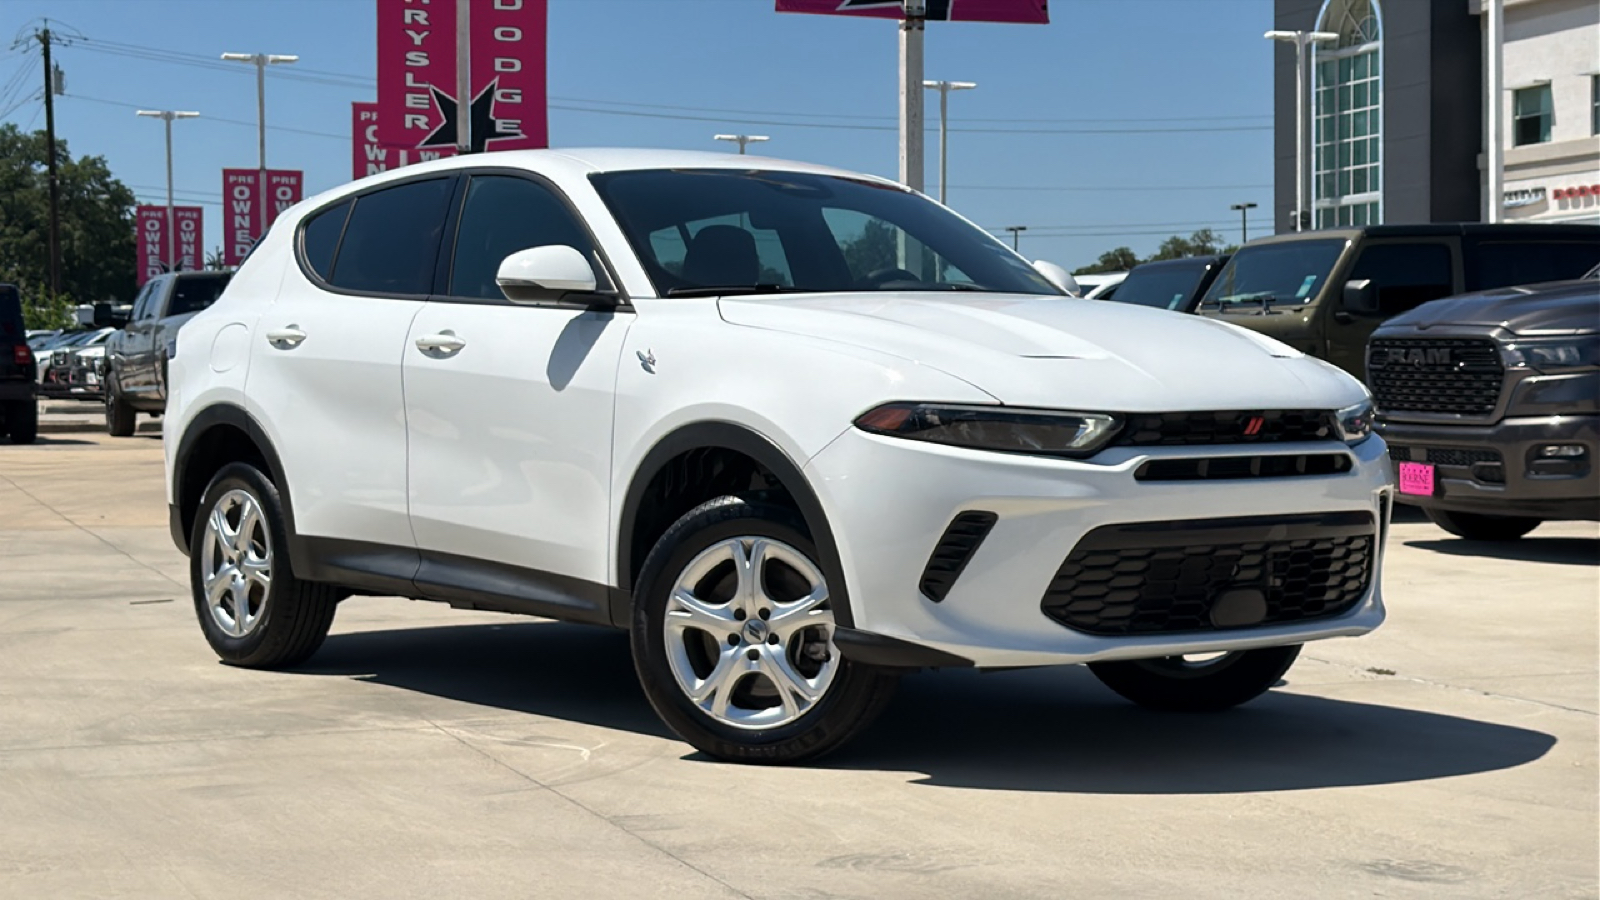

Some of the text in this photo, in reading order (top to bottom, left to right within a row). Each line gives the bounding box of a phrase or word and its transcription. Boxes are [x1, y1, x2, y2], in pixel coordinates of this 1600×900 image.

[404, 0, 430, 130] RYSLER
[493, 0, 522, 135] DODGE
[229, 175, 255, 185] PRE
[272, 176, 297, 185] PRE
[233, 186, 251, 256] OWNED
[1388, 347, 1451, 366] RAM
